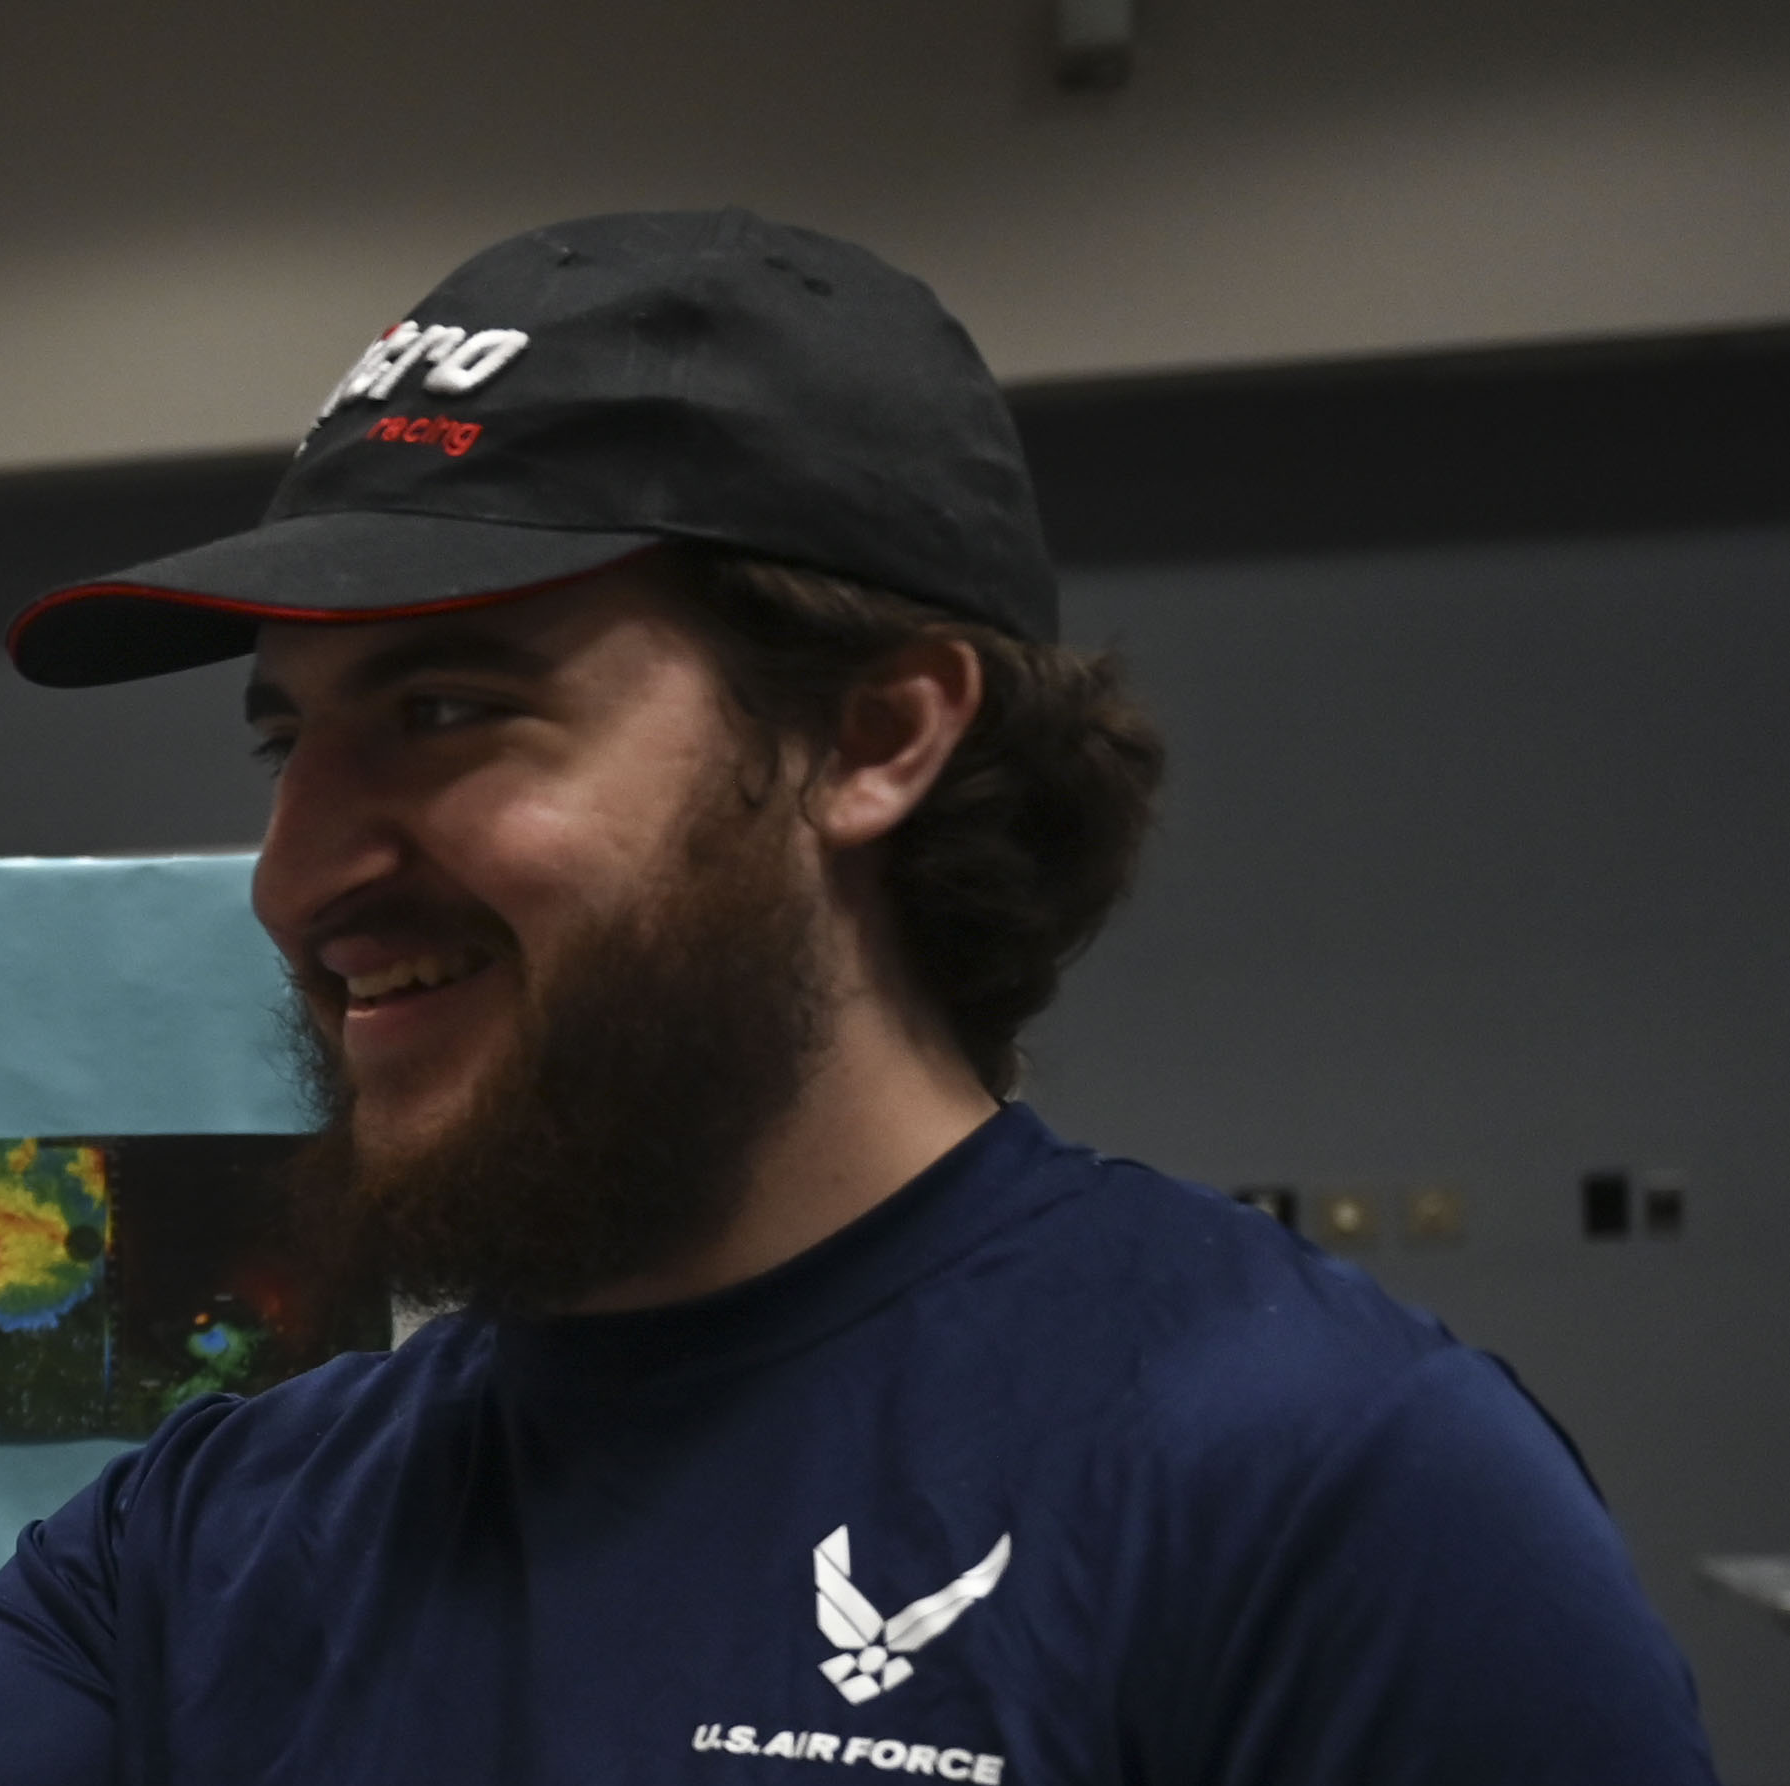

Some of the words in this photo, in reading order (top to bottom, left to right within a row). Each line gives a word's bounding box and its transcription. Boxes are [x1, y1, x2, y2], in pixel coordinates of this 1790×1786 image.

[366, 414, 484, 458] racing
[691, 1723, 760, 1755] U.S.
[762, 1729, 841, 1765] AIR
